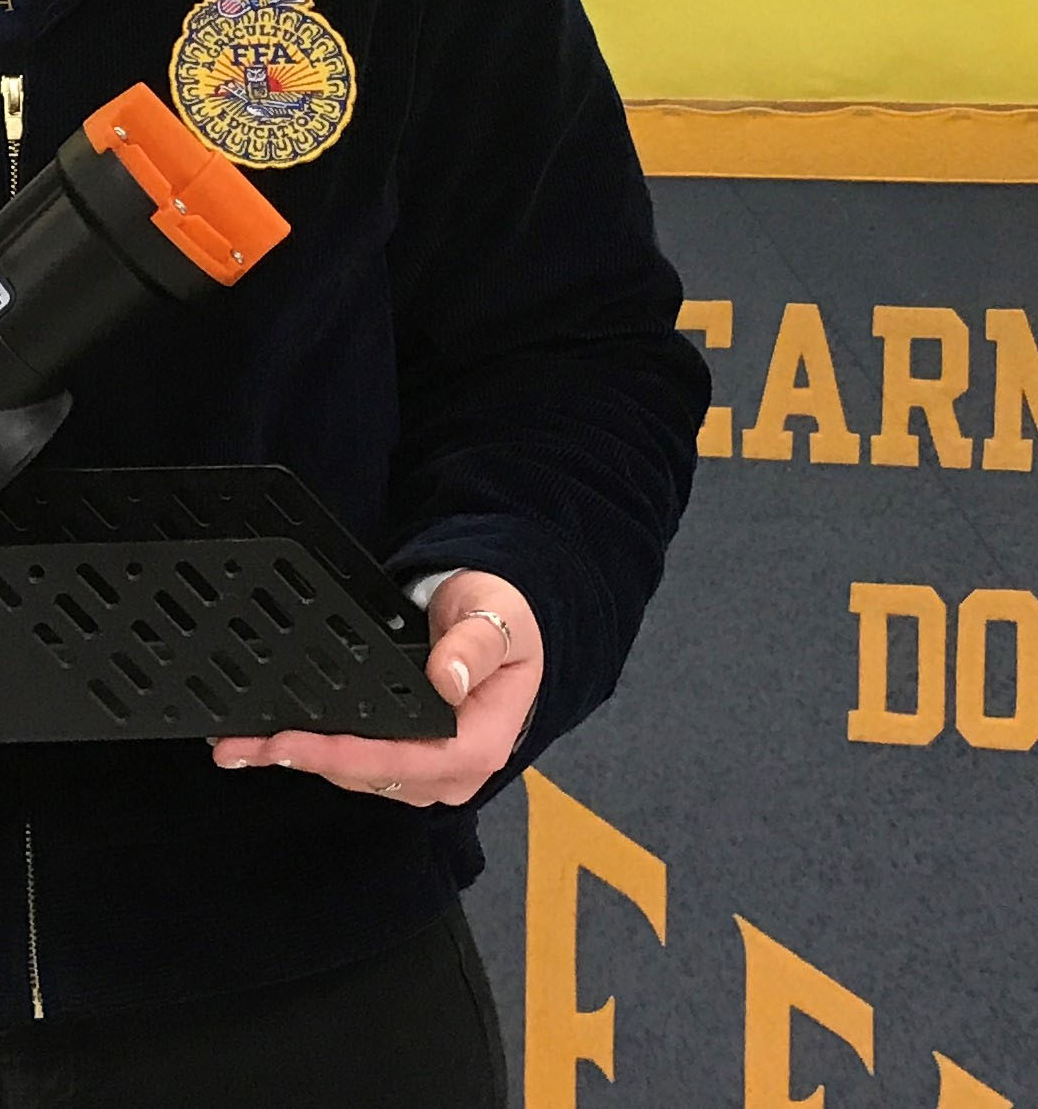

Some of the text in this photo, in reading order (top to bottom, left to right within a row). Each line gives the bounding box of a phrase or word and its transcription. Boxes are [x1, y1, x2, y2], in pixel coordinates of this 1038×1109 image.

[200, 24, 322, 72] AGRICULTURAL
[229, 43, 297, 67] FFA
[218, 104, 320, 141] EDUCATION
[847, 581, 1038, 751] DO
